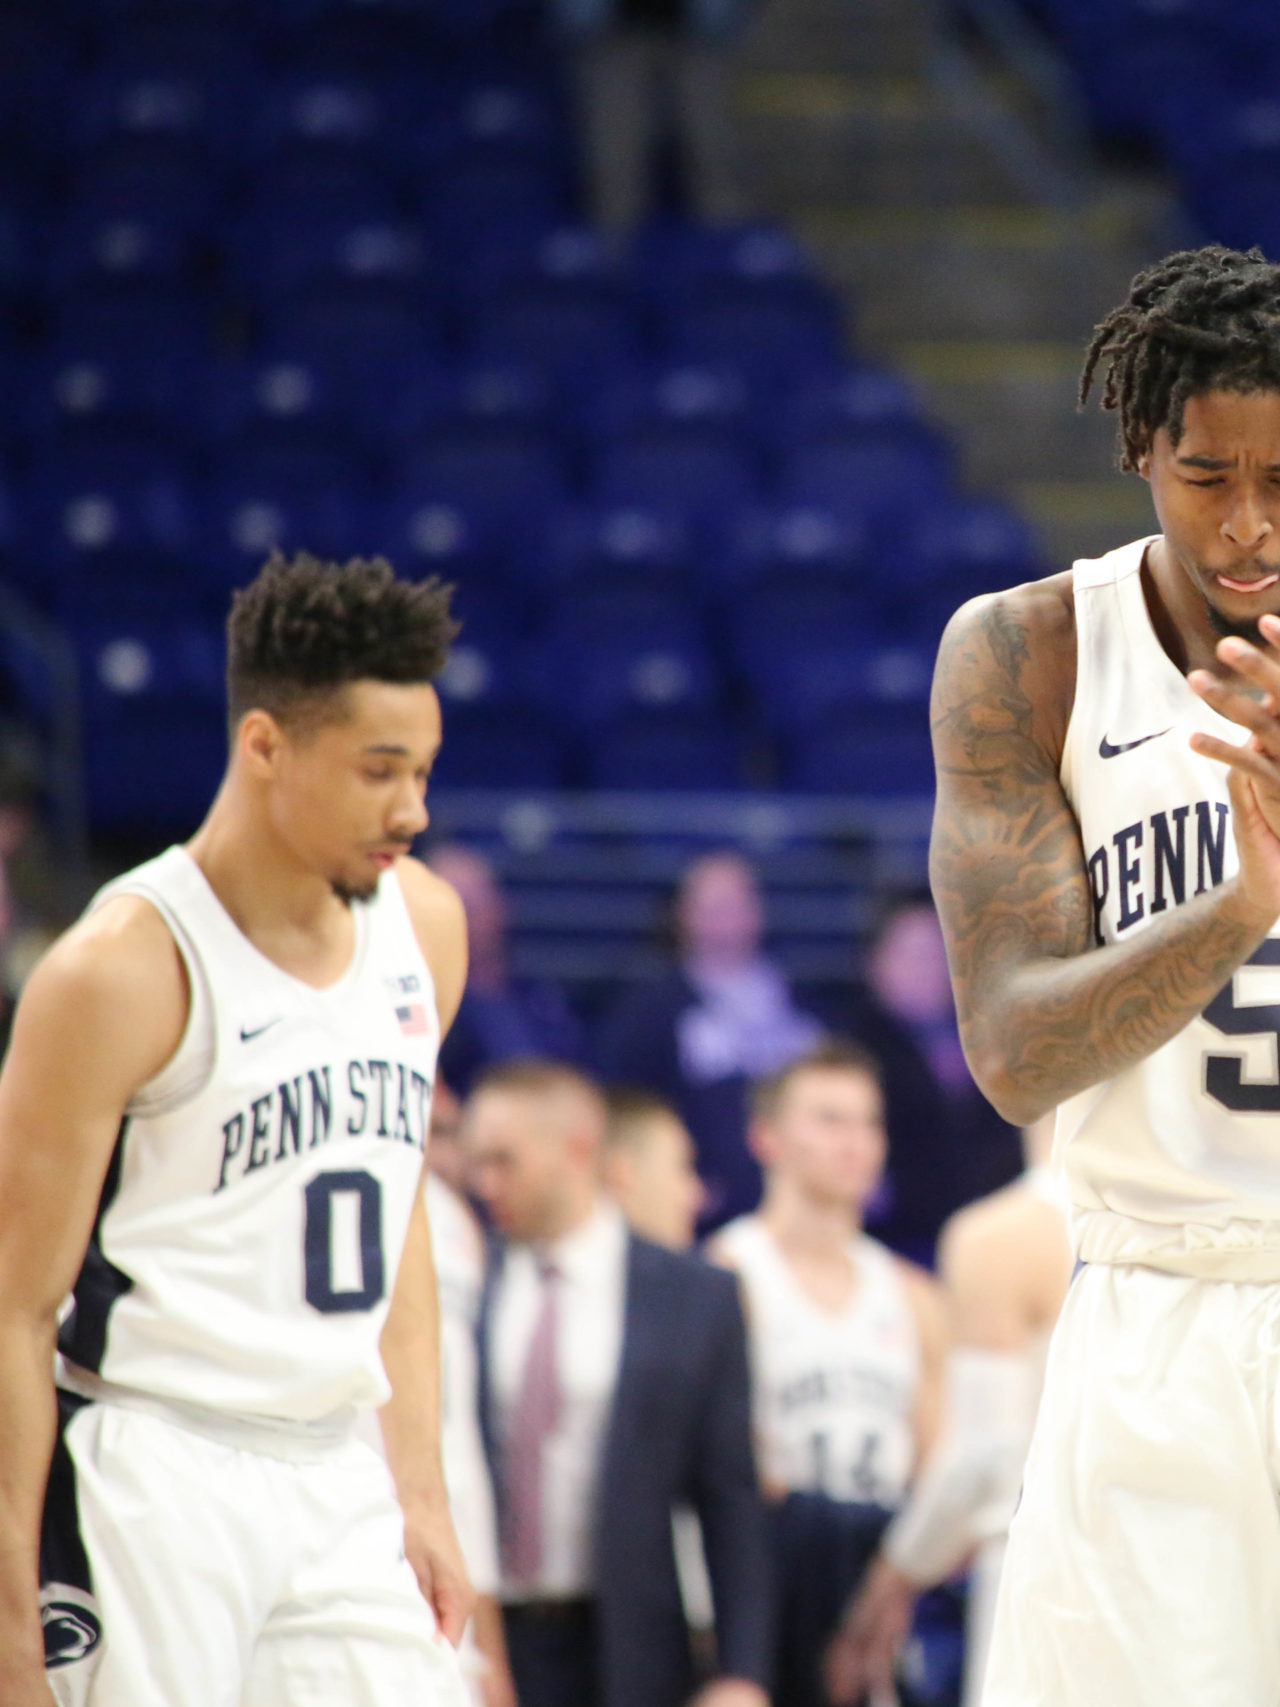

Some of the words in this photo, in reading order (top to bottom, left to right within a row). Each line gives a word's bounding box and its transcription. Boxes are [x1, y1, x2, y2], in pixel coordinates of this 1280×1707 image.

[1089, 800, 1230, 947] PENN
[212, 1064, 332, 1196] PENN
[303, 1168, 387, 1314] 0
